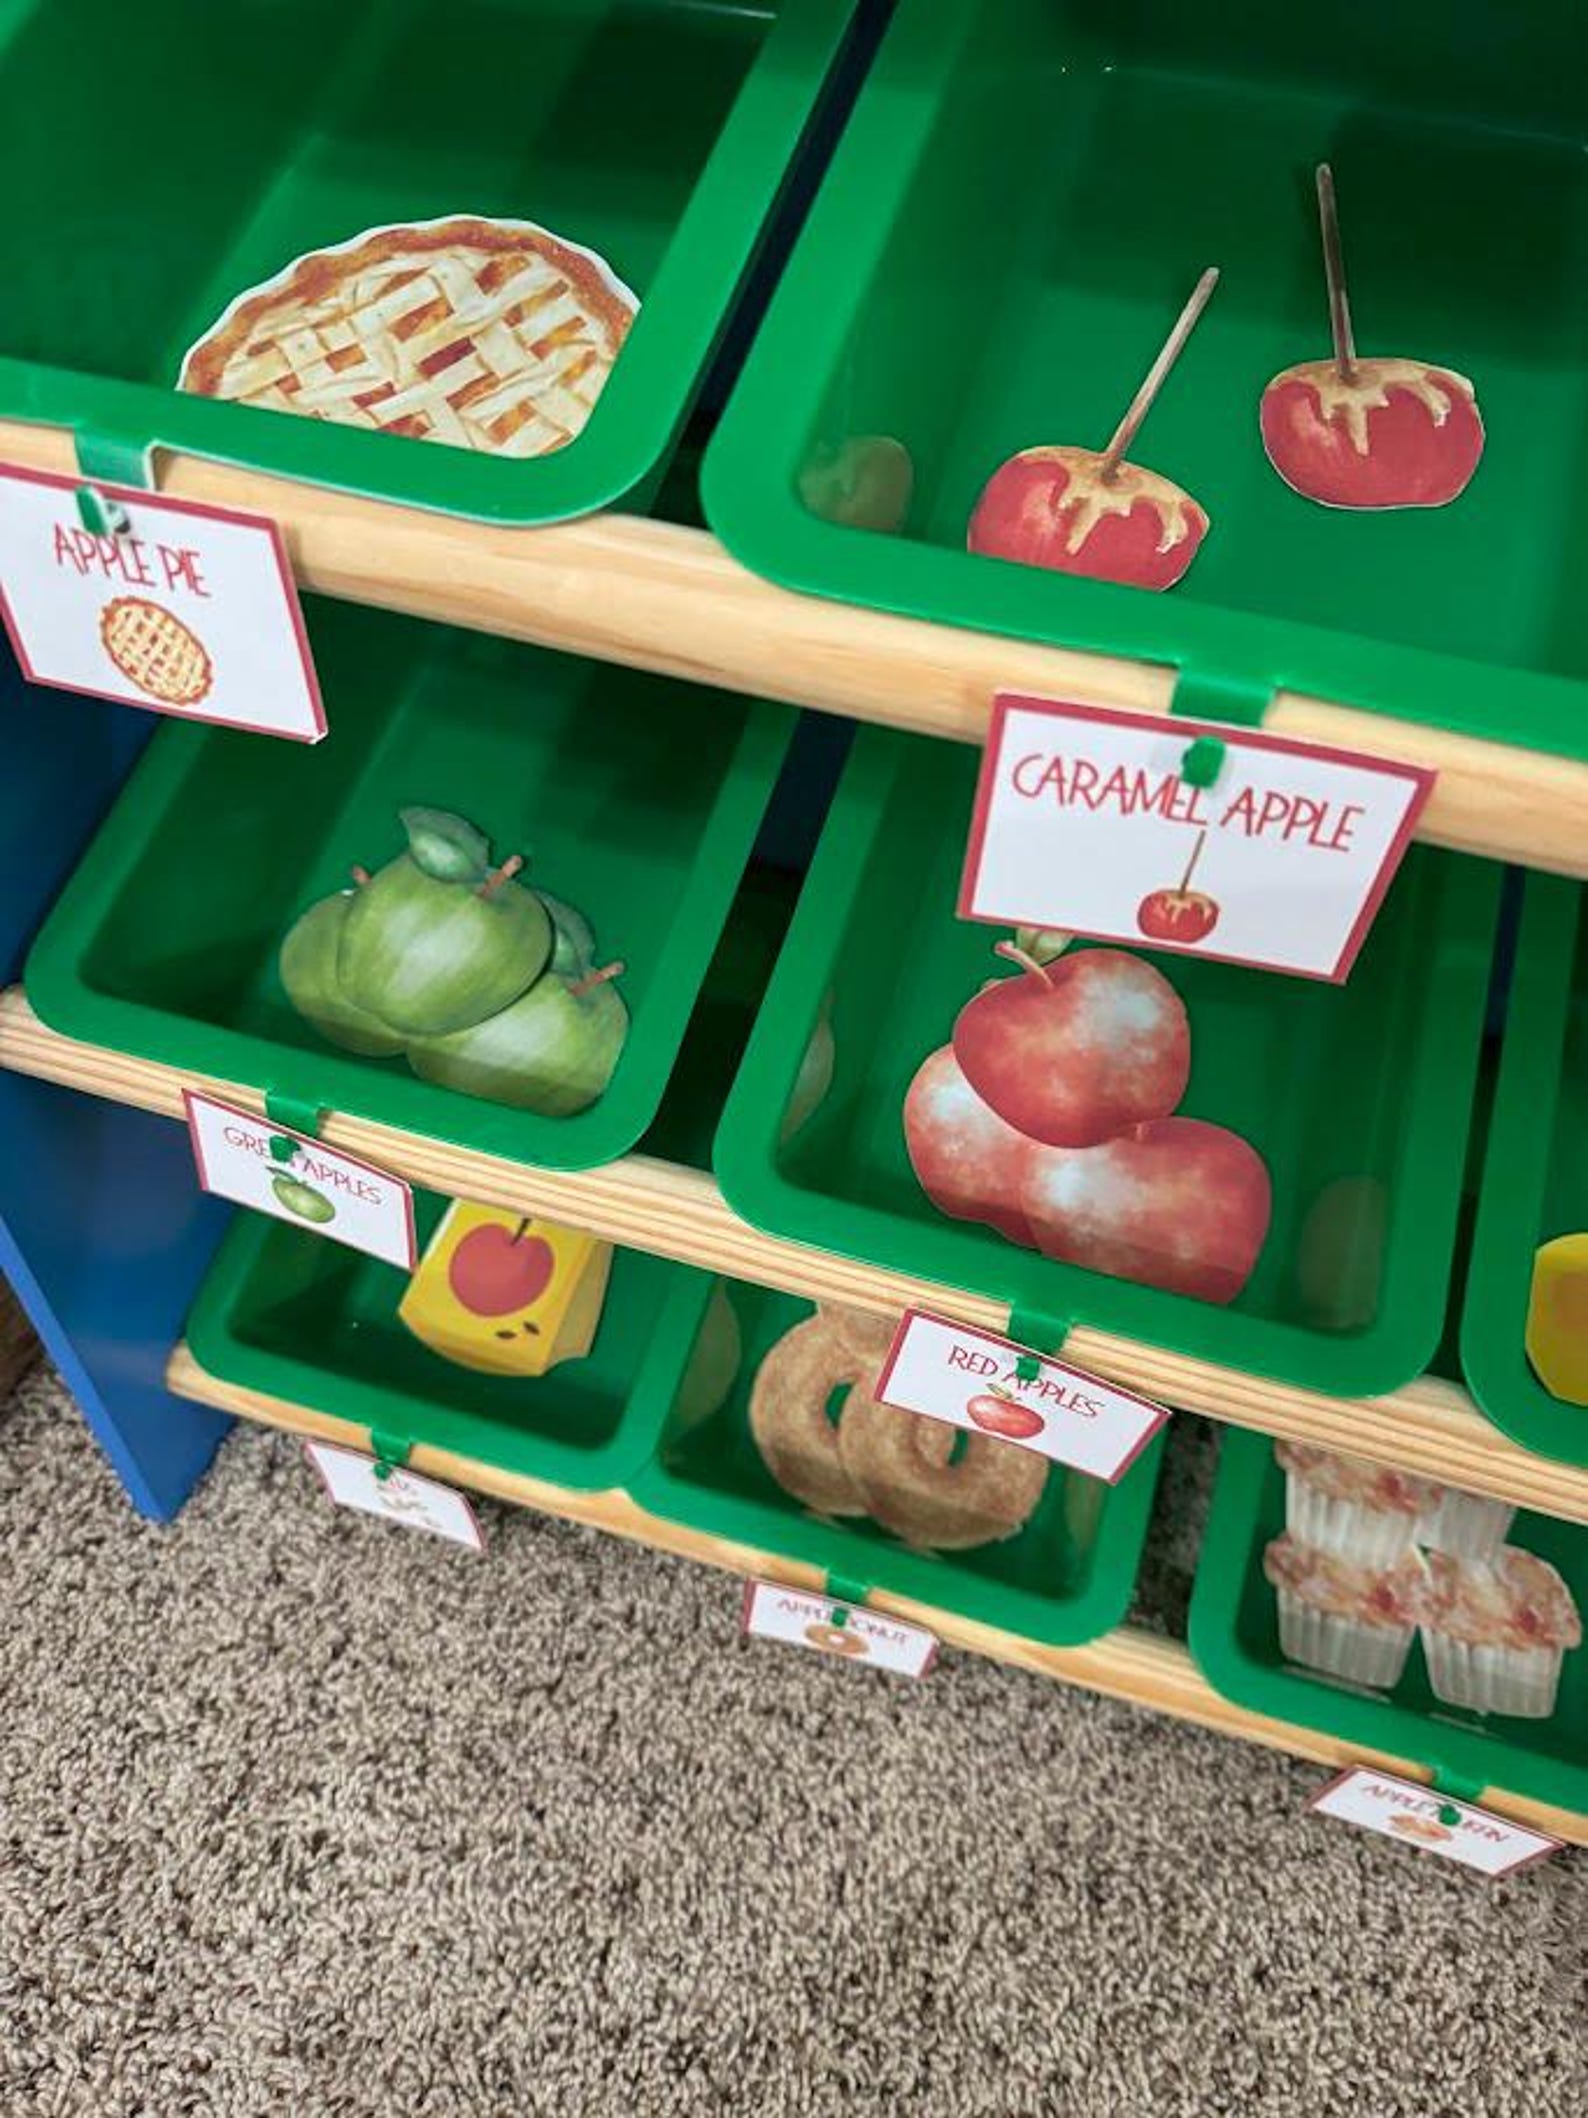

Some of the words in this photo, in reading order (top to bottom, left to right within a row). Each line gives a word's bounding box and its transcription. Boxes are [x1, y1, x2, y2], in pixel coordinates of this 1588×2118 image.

[54, 520, 156, 587] APPLE
[157, 543, 212, 597] PIE
[1012, 753, 1207, 827] CARAMEL
[1220, 787, 1364, 853] APPLE
[303, 1157, 382, 1206] APPLES
[948, 1345, 999, 1377] RED
